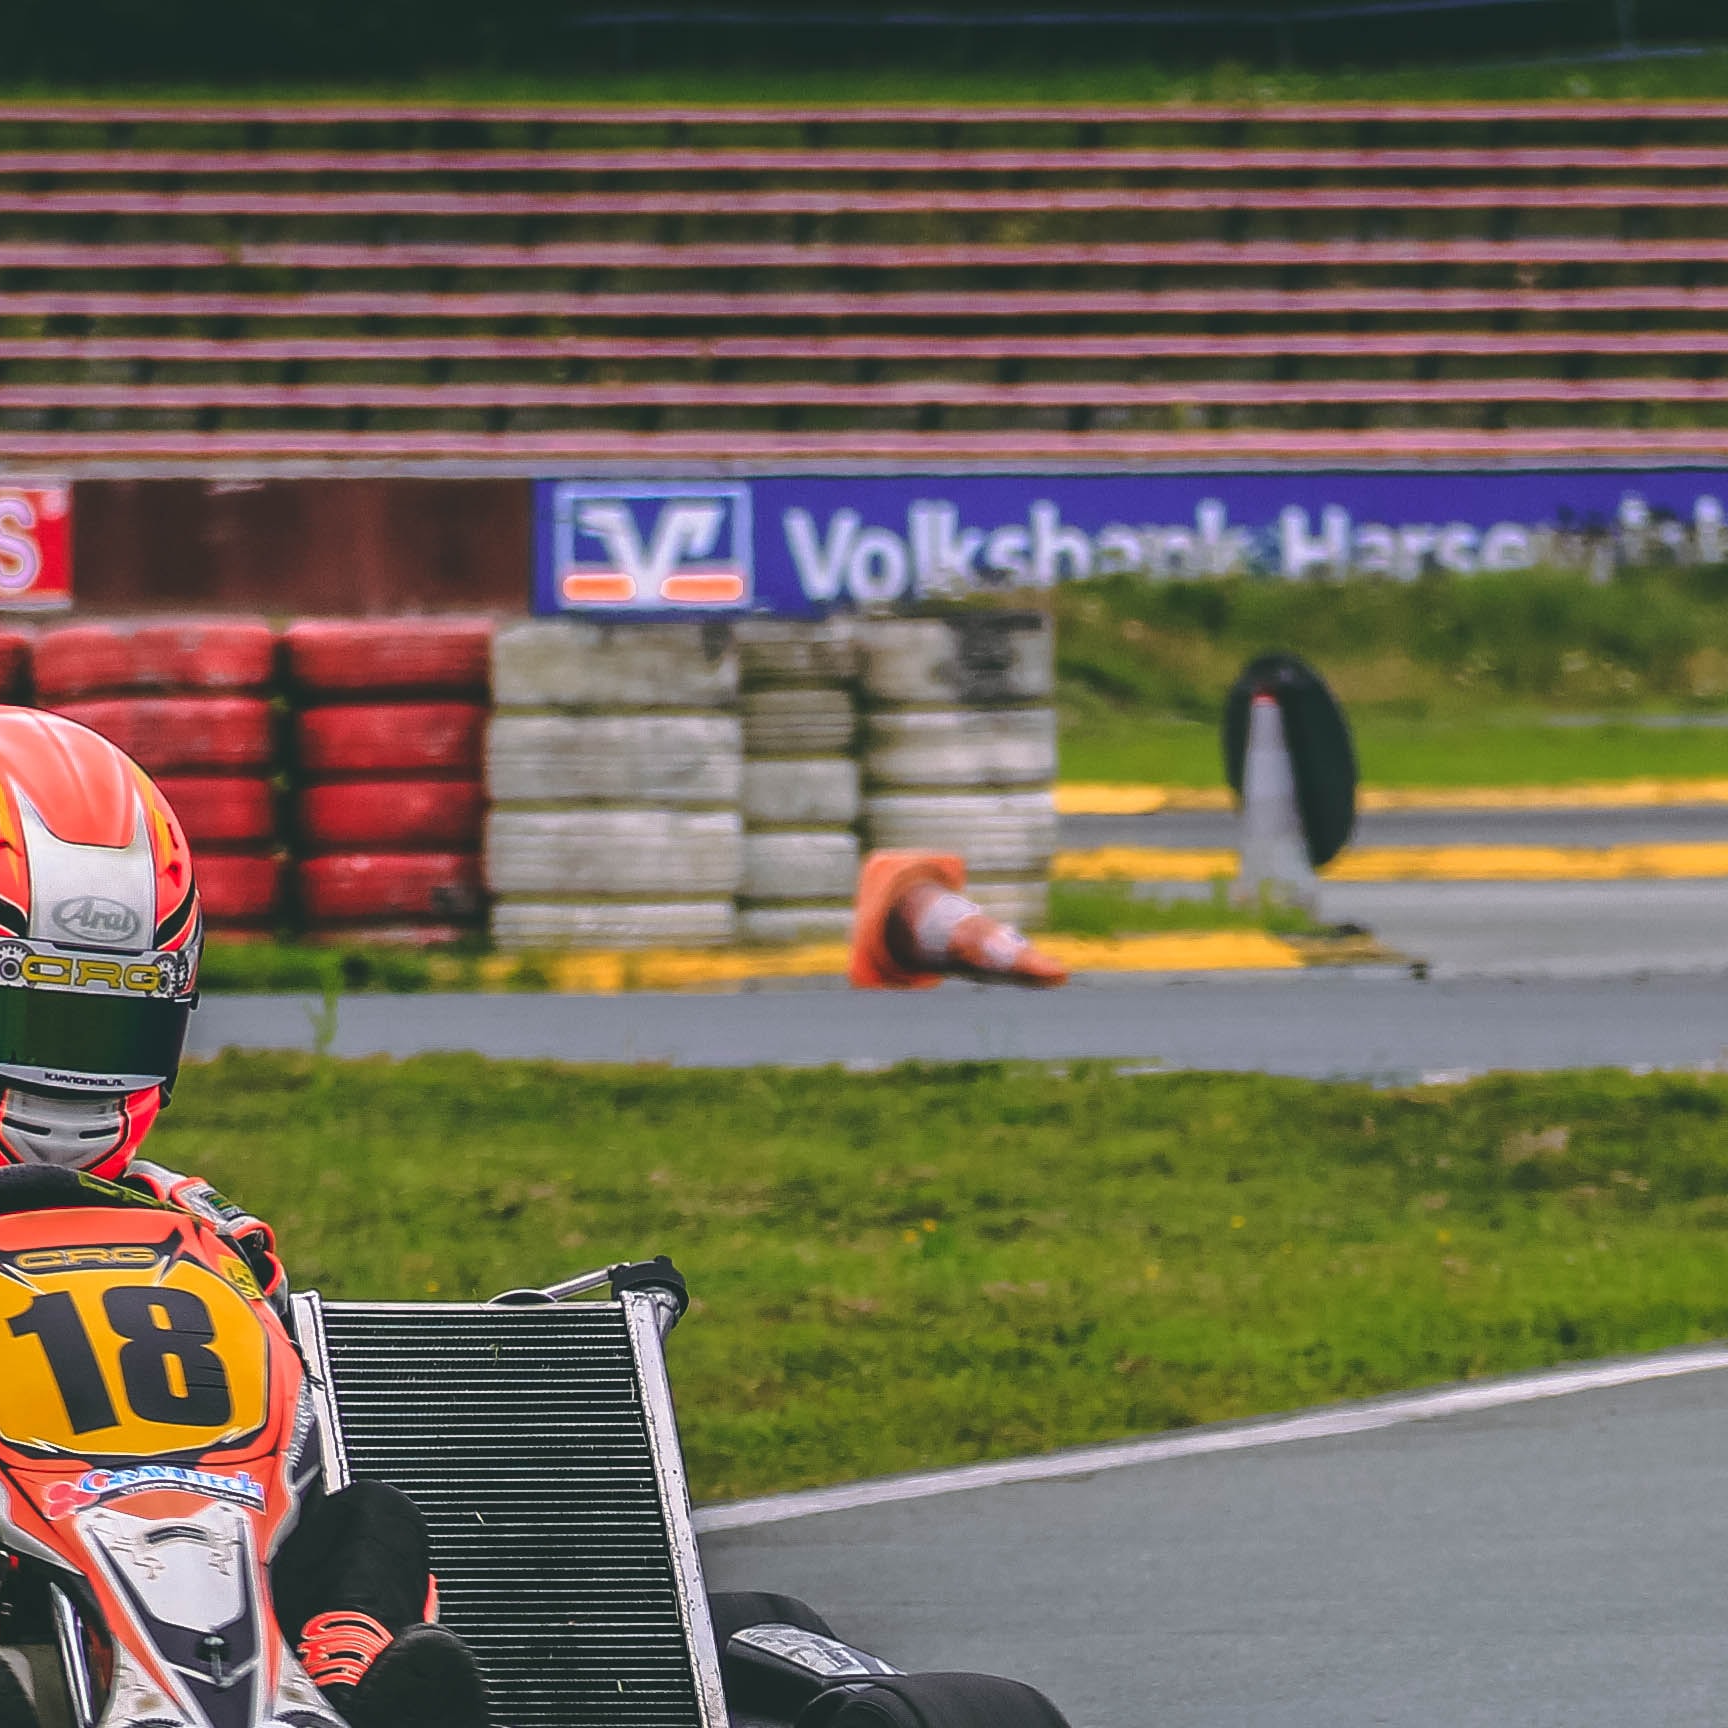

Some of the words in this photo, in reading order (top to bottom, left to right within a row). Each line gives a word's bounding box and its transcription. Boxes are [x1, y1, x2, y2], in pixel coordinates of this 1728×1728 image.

[60, 899, 132, 931] Arai
[22, 954, 161, 991] CRG
[15, 1246, 161, 1269] CRG
[5, 1285, 233, 1435] 18
